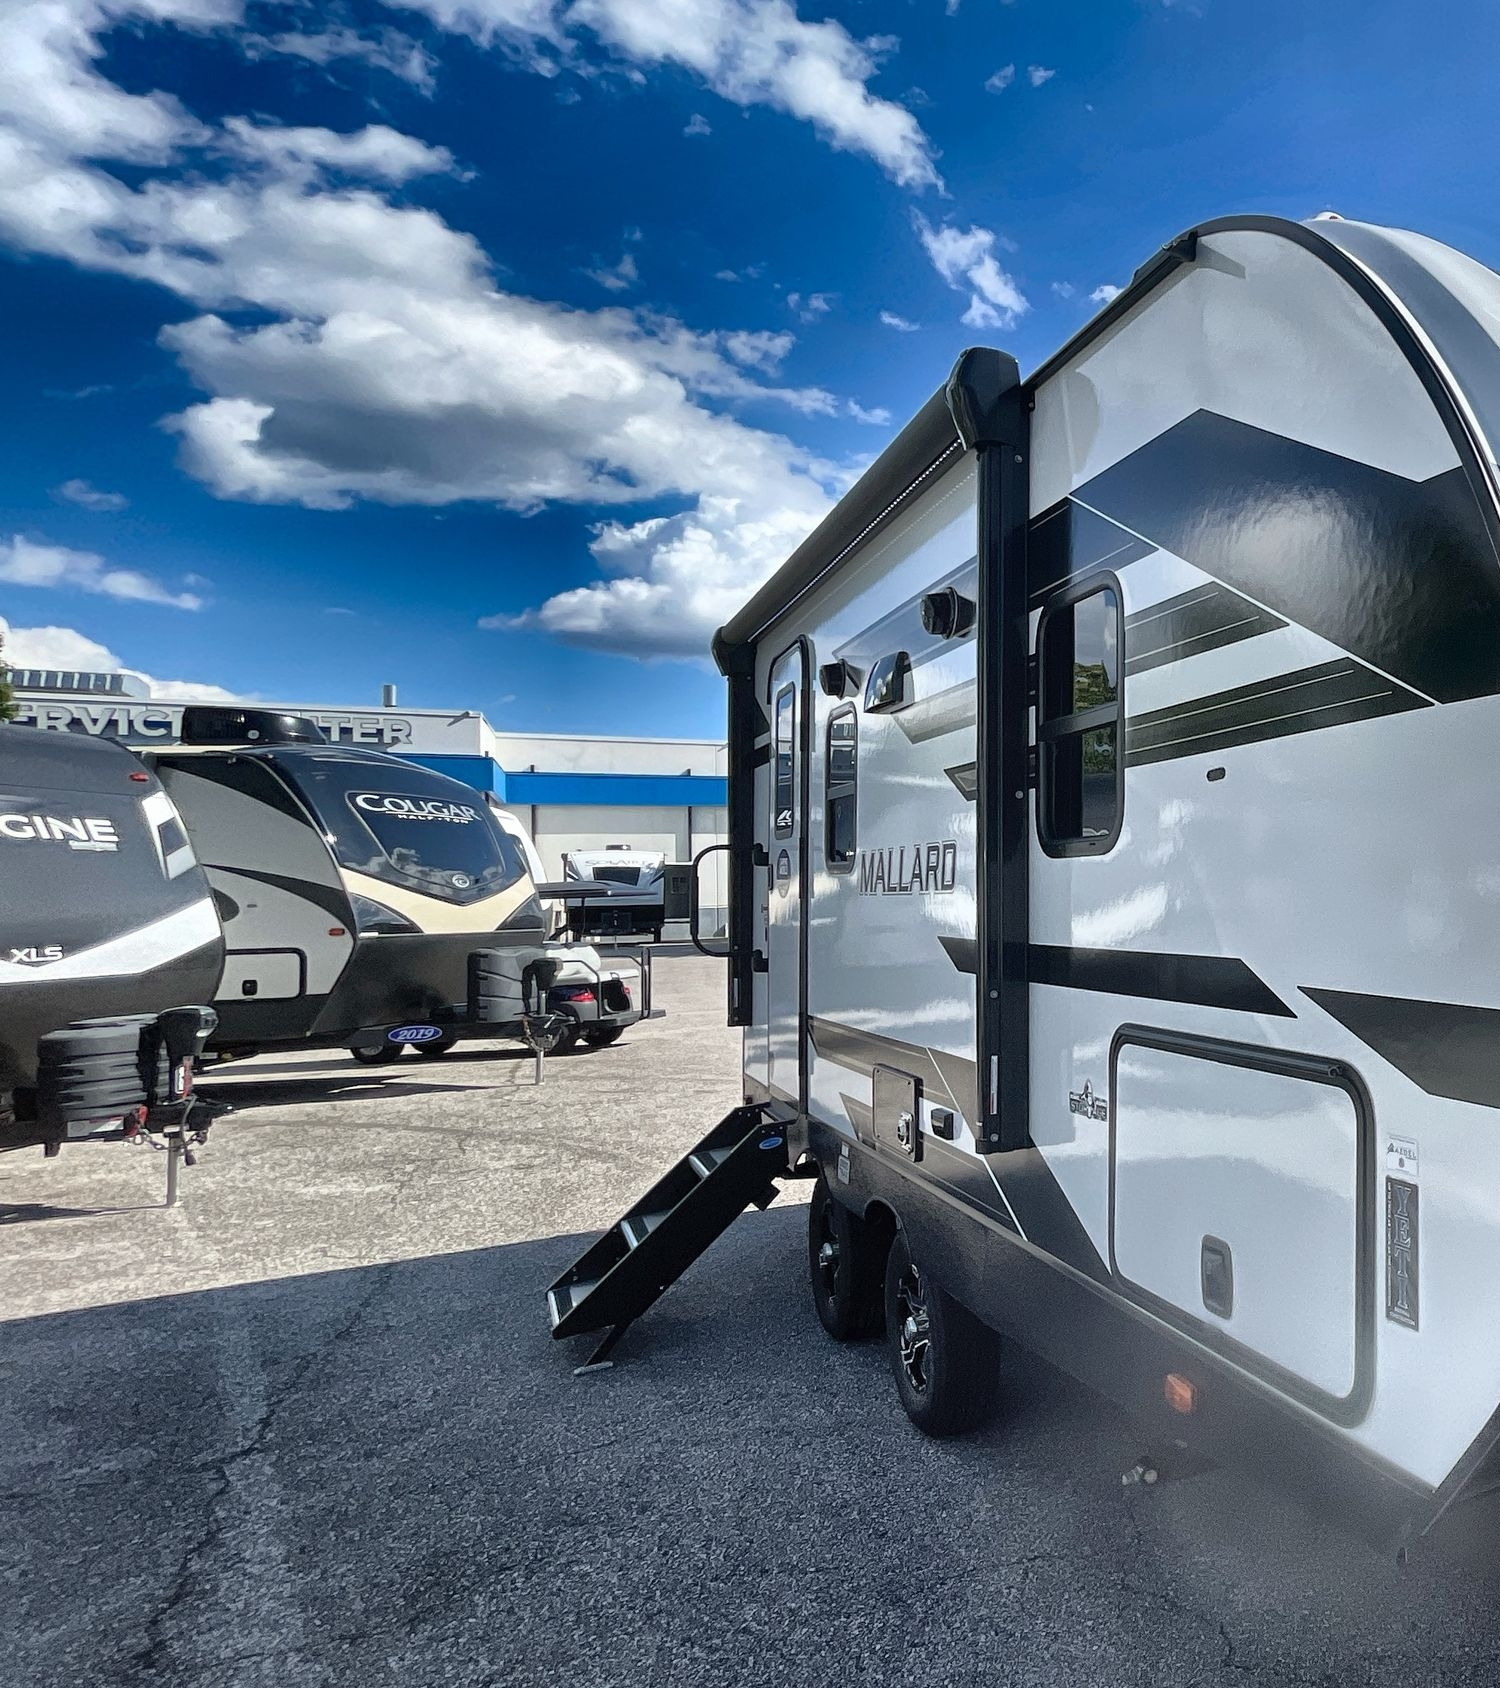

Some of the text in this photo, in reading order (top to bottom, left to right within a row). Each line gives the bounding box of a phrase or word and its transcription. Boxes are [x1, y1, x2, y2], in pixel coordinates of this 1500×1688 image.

[356, 794, 482, 821] COUGAR
[859, 840, 957, 895] MALLARD
[10, 946, 64, 963] XLS
[397, 1029, 435, 1040] 2019
[1393, 1183, 1412, 1310] YETI
